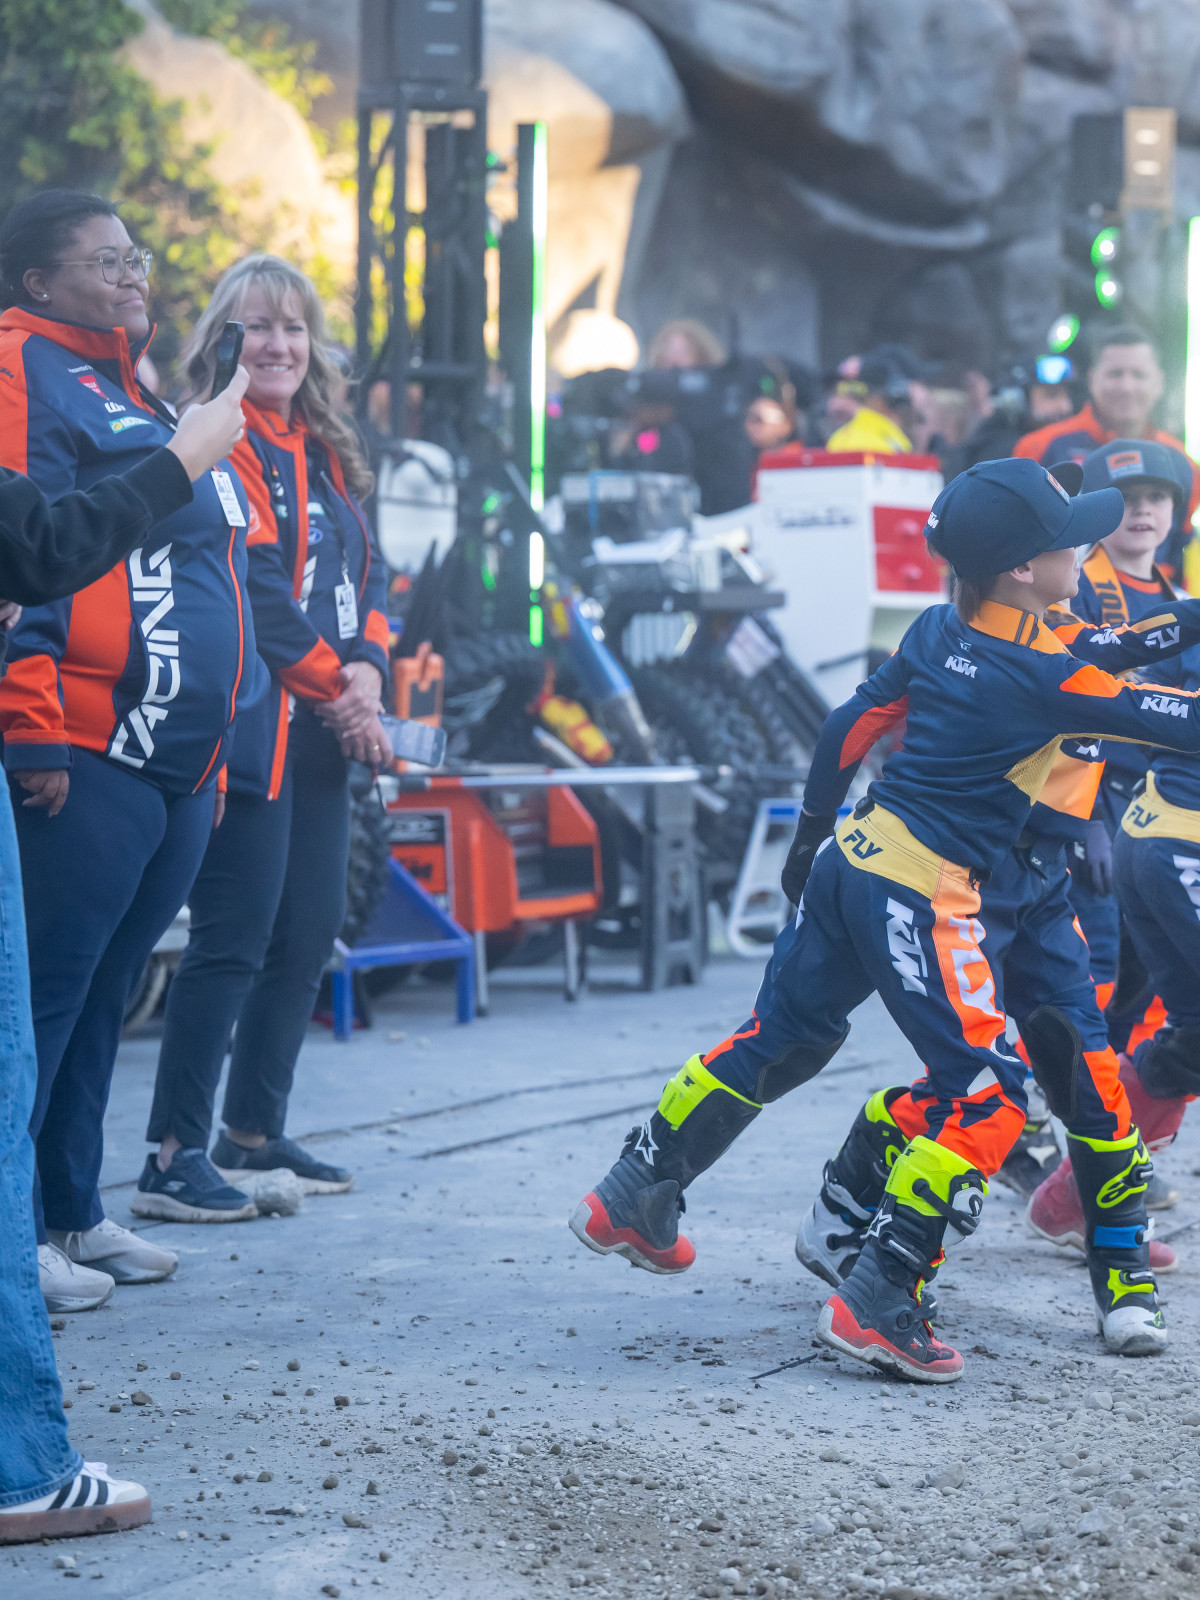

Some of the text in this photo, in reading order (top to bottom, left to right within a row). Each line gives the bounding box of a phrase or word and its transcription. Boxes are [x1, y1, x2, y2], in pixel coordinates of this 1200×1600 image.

[1144, 625, 1180, 650] FLY
[944, 655, 978, 679] KTM
[1140, 693, 1189, 719] KTM
[1126, 804, 1160, 829] FLY
[842, 828, 884, 860] FLY
[886, 896, 928, 997] KTM
